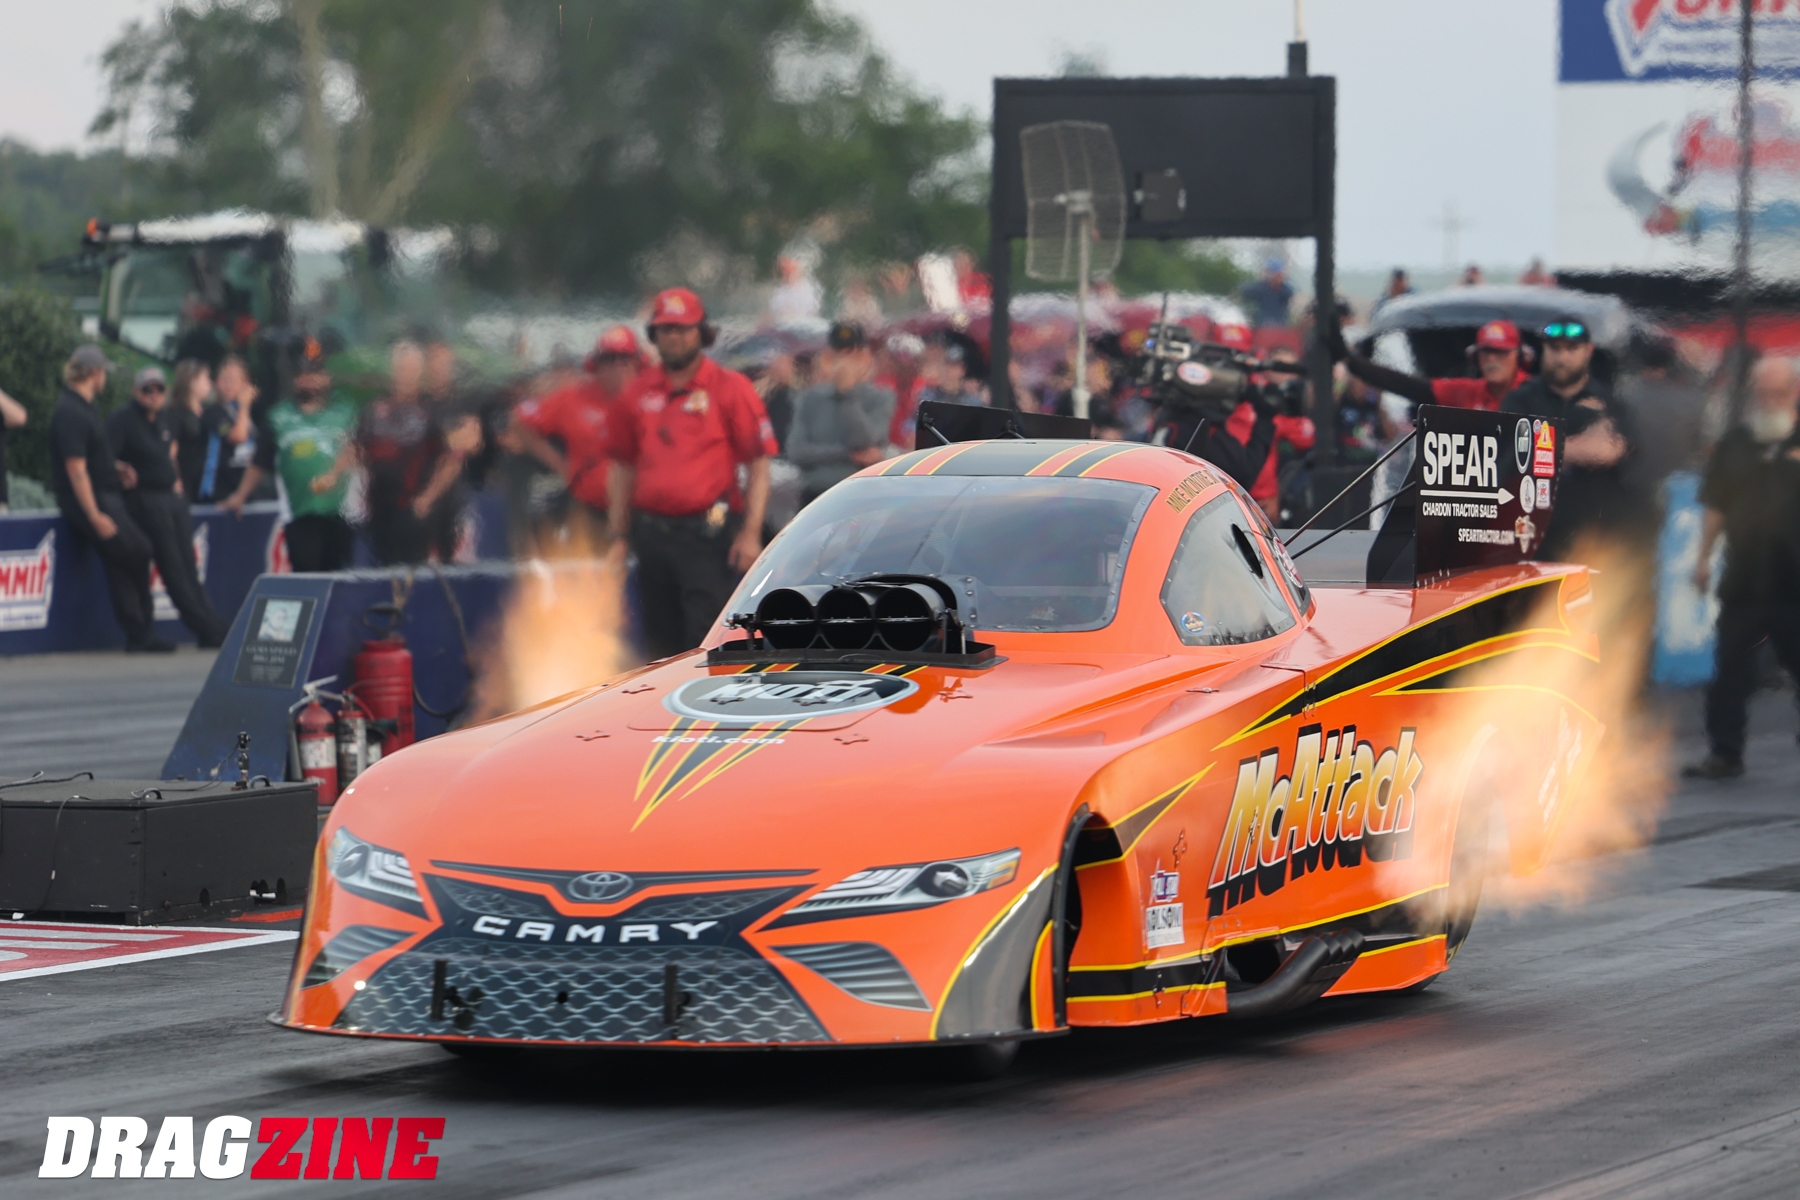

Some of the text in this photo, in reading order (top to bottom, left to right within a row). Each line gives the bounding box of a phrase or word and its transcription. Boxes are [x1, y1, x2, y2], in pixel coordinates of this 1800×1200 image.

[1423, 431, 1498, 487] SPEAR
[1166, 488, 1191, 514] MIKE
[1423, 502, 1498, 519] CHARDON TRACTOR SALES
[651, 736, 786, 745] kioti.com
[1207, 728, 1424, 890] McAttack
[472, 915, 718, 943] CAMRY
